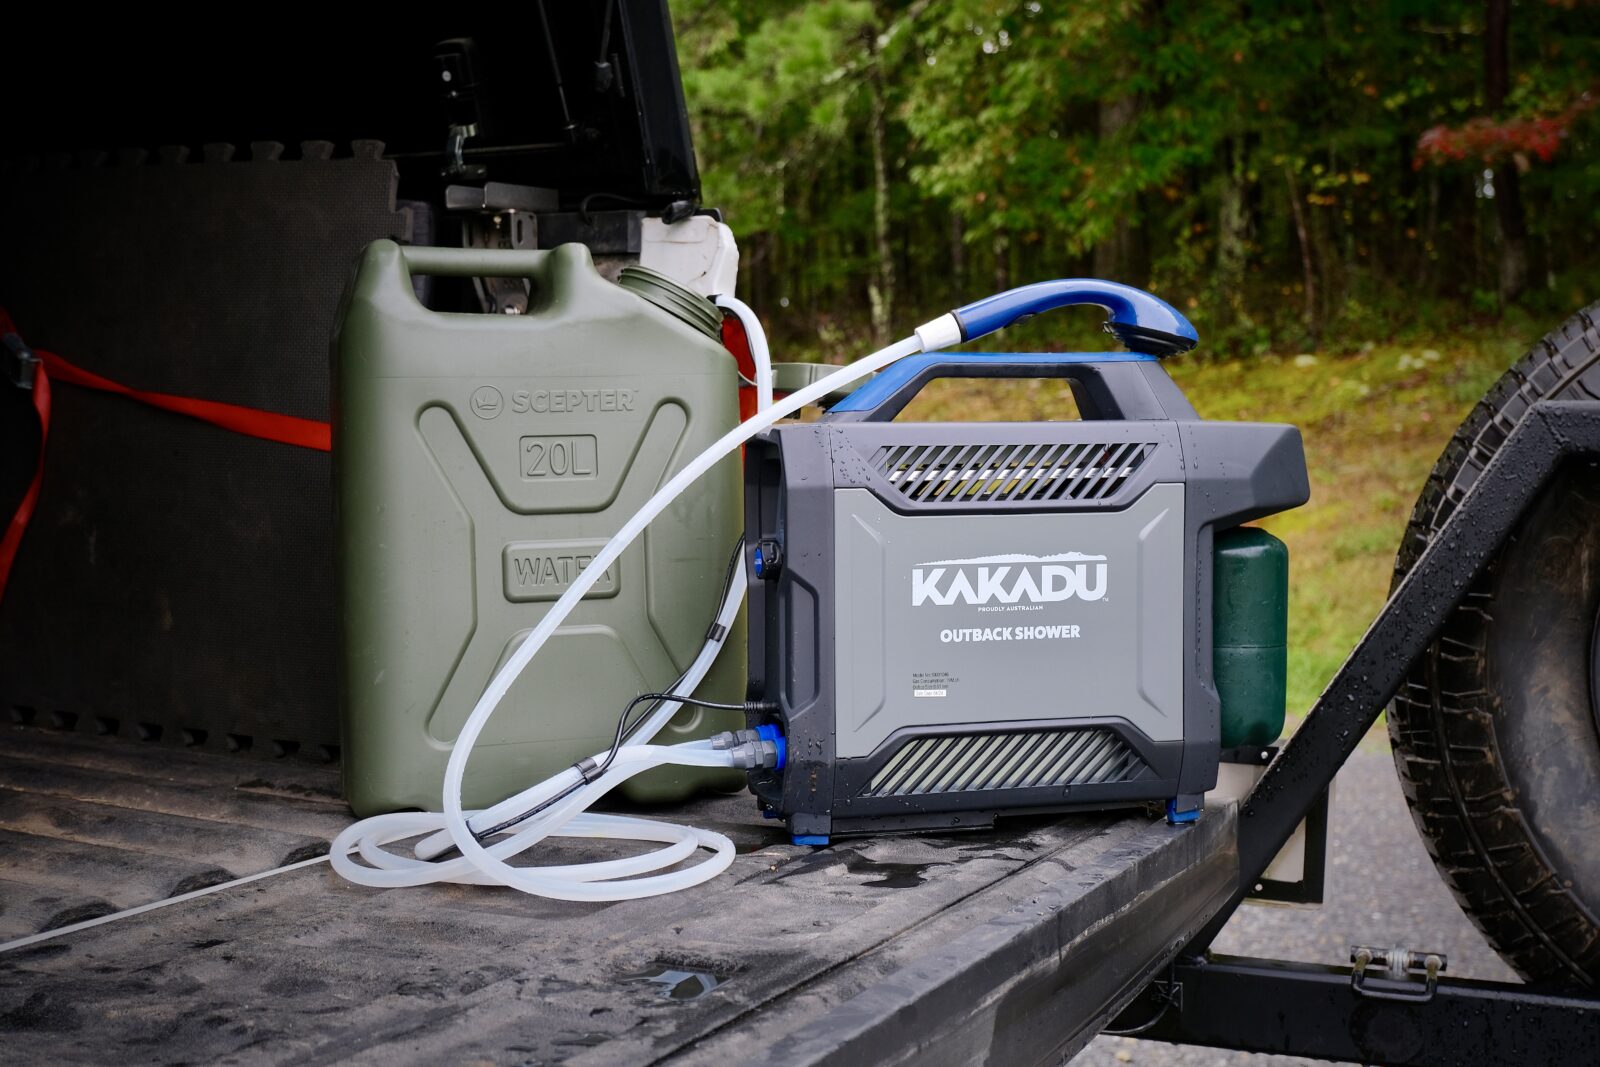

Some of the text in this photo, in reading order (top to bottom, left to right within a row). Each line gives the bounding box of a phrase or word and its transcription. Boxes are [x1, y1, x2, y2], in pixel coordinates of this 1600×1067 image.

[511, 389, 634, 414] SCEPTER
[525, 441, 593, 477] 20L
[911, 563, 1108, 607] KAKADU
[939, 624, 1081, 643] OUTBACK SHOWER
